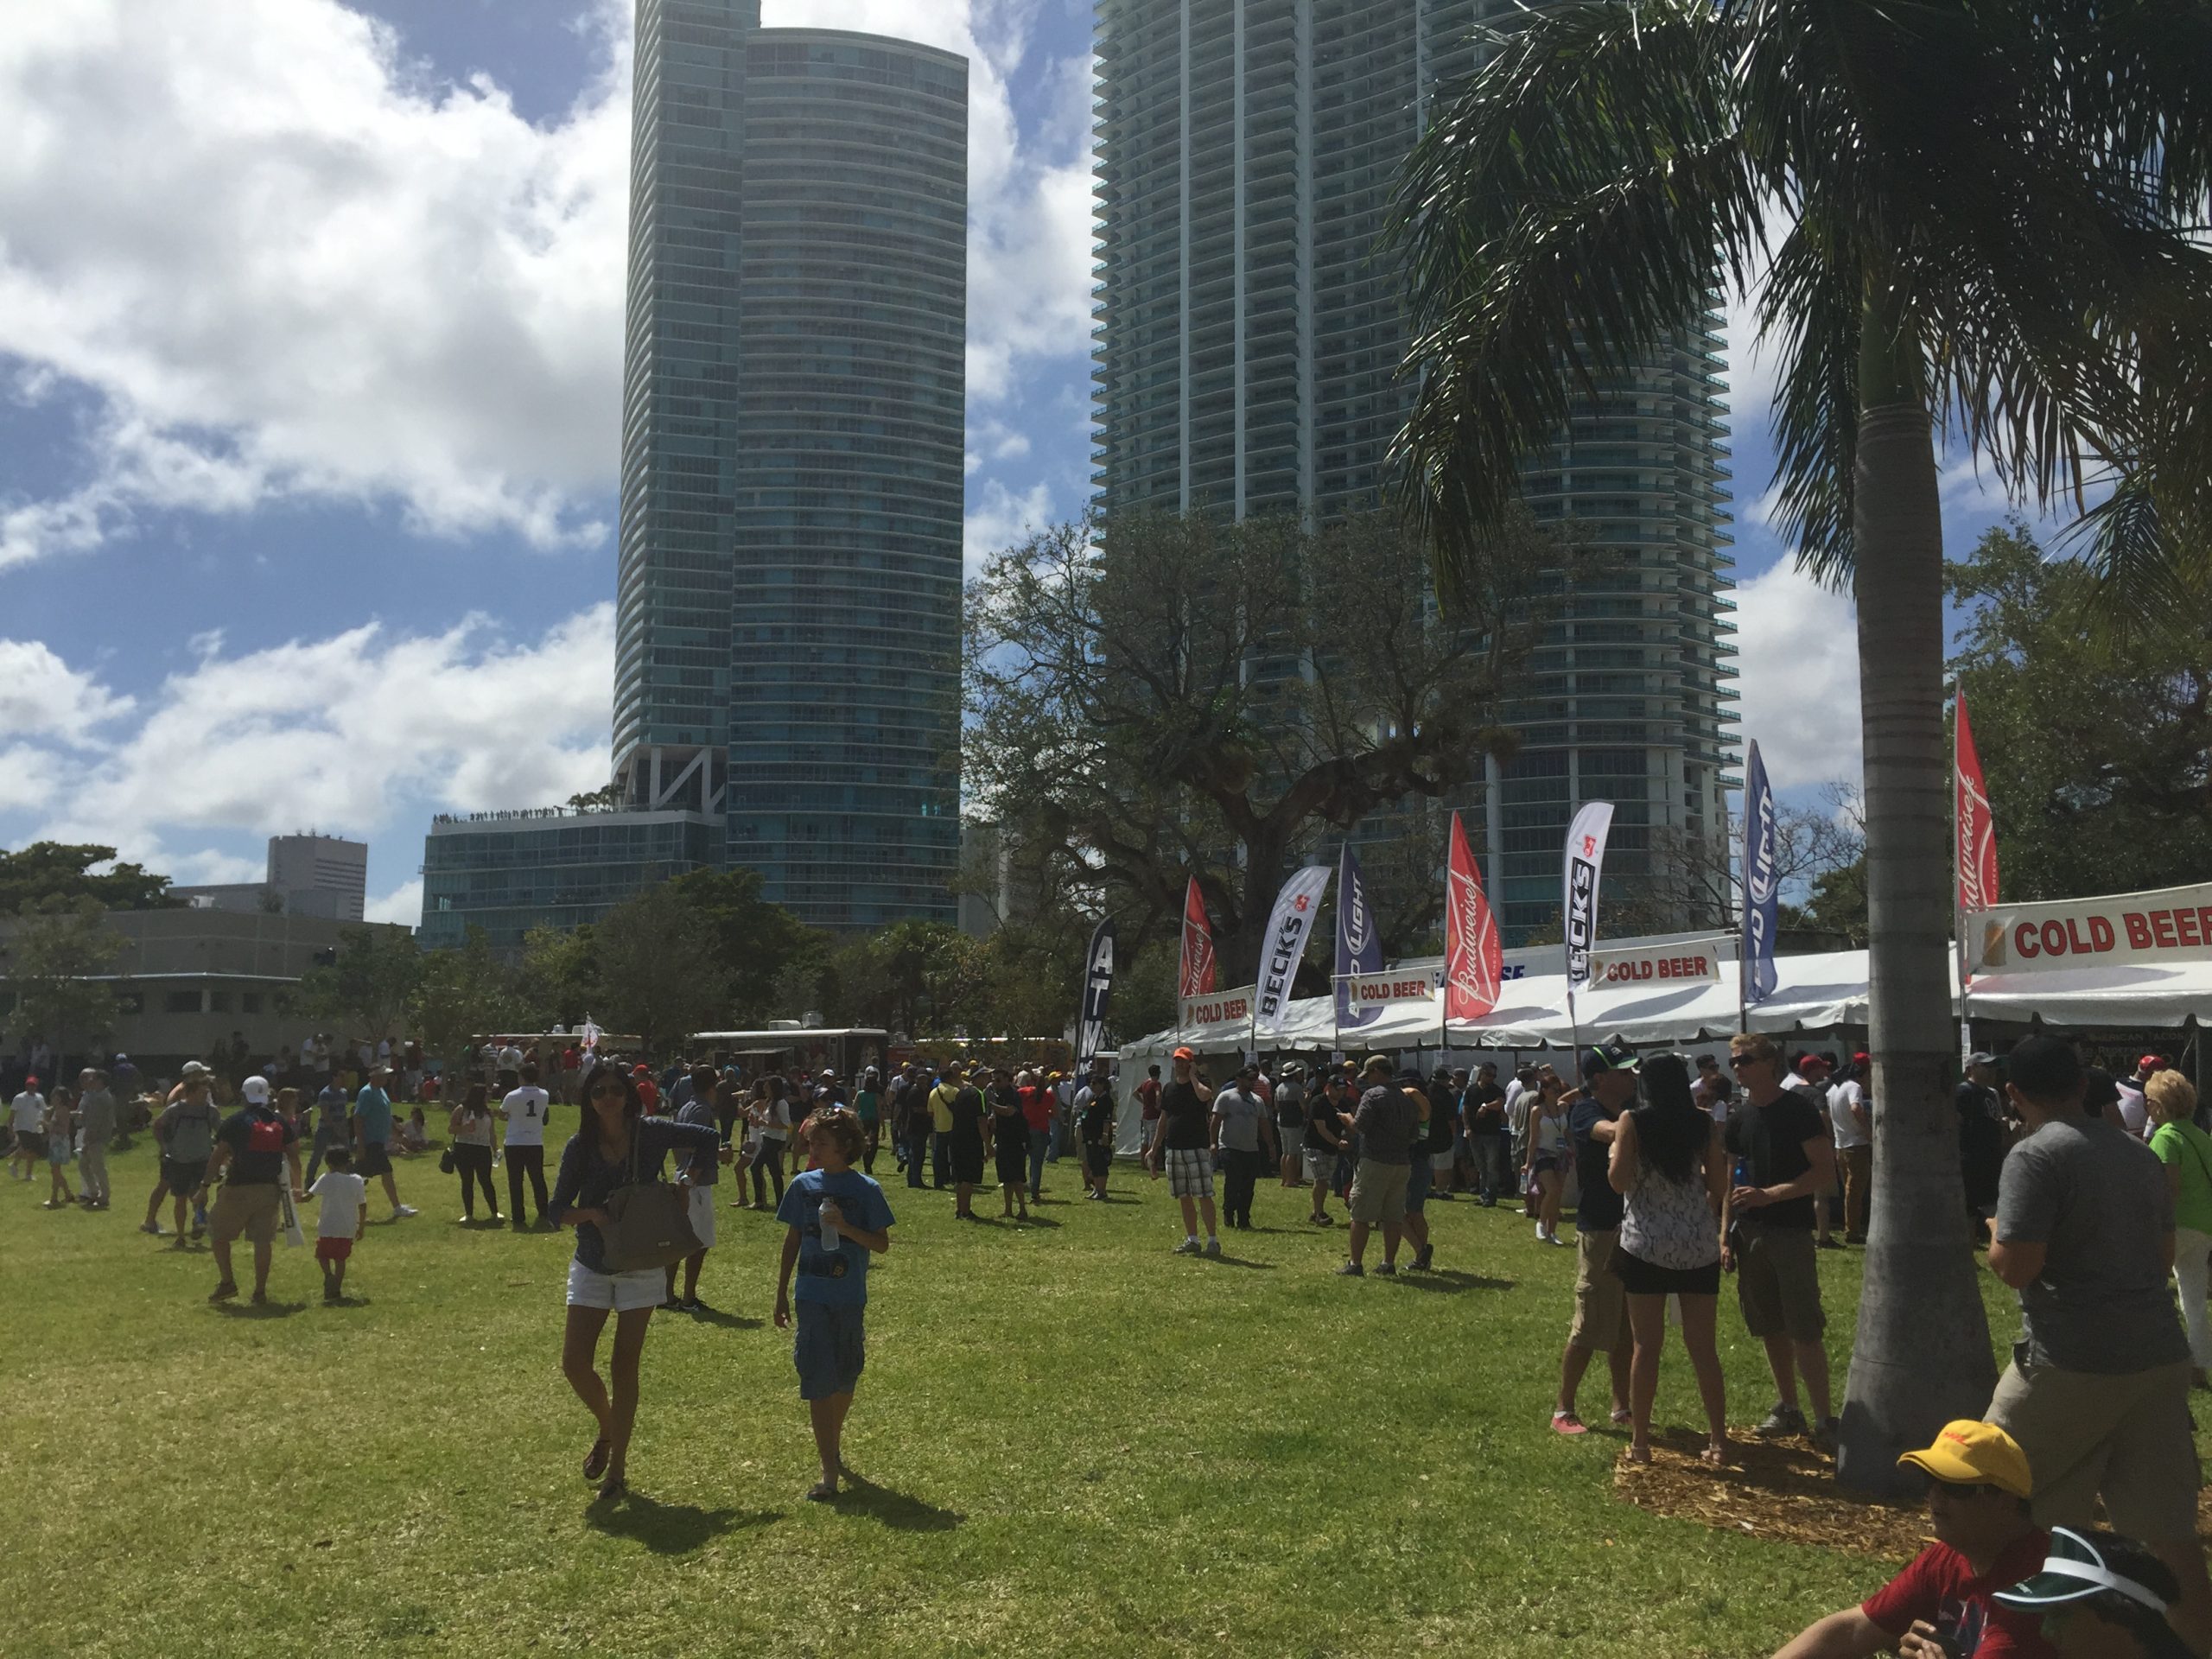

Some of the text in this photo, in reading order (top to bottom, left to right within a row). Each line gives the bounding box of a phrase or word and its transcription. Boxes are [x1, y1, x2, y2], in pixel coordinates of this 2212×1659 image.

[1350, 871, 1363, 949] LIGHT
[1459, 874, 1480, 1006] Budweiser
[2015, 916, 2115, 959] COLD
[1259, 916, 1303, 1017] BECK'S
[1606, 956, 1708, 982] COLD BEER
[1361, 980, 1425, 1001] COLD BEER
[1196, 998, 1248, 1024] COLD BEER
[526, 1100, 537, 1117] 1
